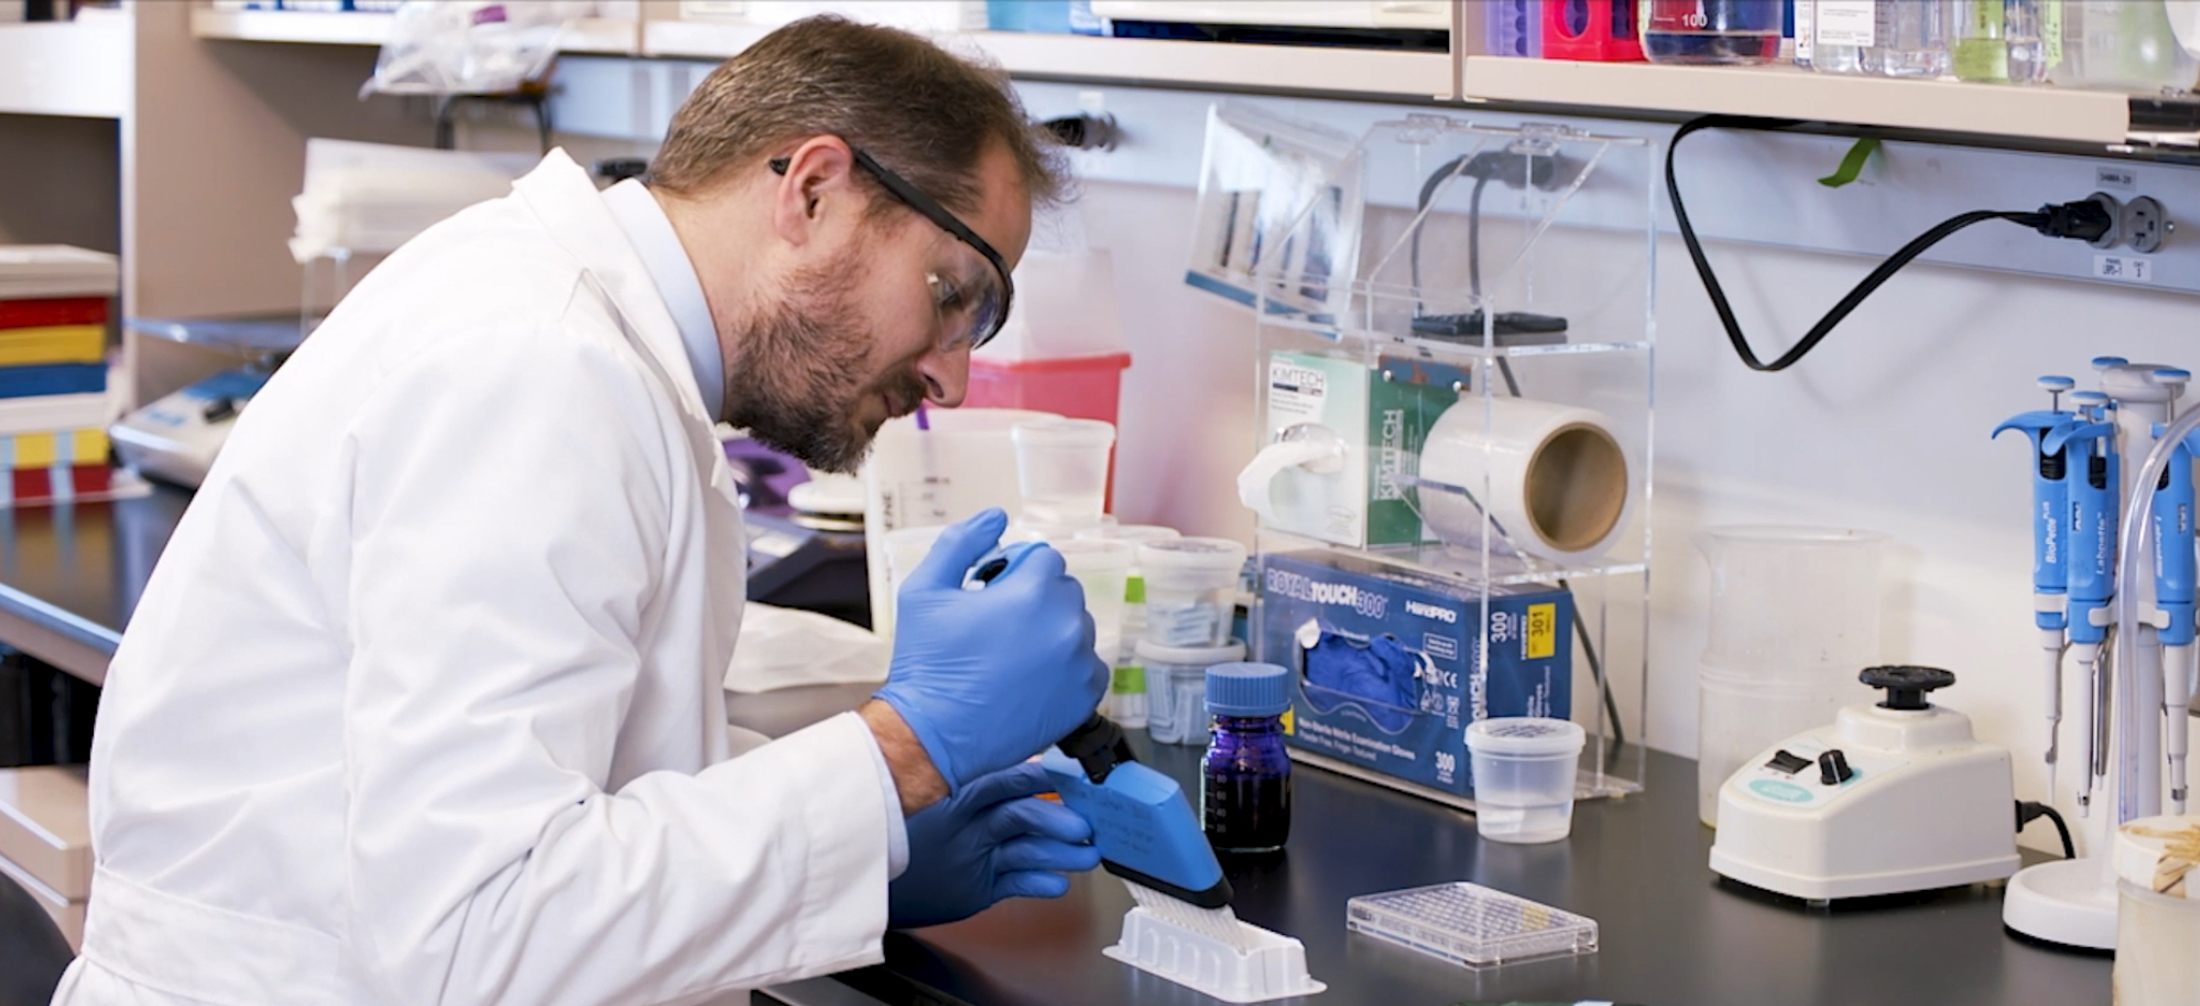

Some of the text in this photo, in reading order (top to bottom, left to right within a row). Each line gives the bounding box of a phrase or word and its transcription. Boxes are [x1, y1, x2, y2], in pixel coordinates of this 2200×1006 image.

[1681, 13, 1708, 27] 100
[1272, 366, 1324, 389] KIMTECH
[1380, 409, 1397, 500] KIMTECH
[1490, 611, 1508, 643] 300
[1531, 611, 1545, 637] 301
[1435, 751, 1456, 773] 300
